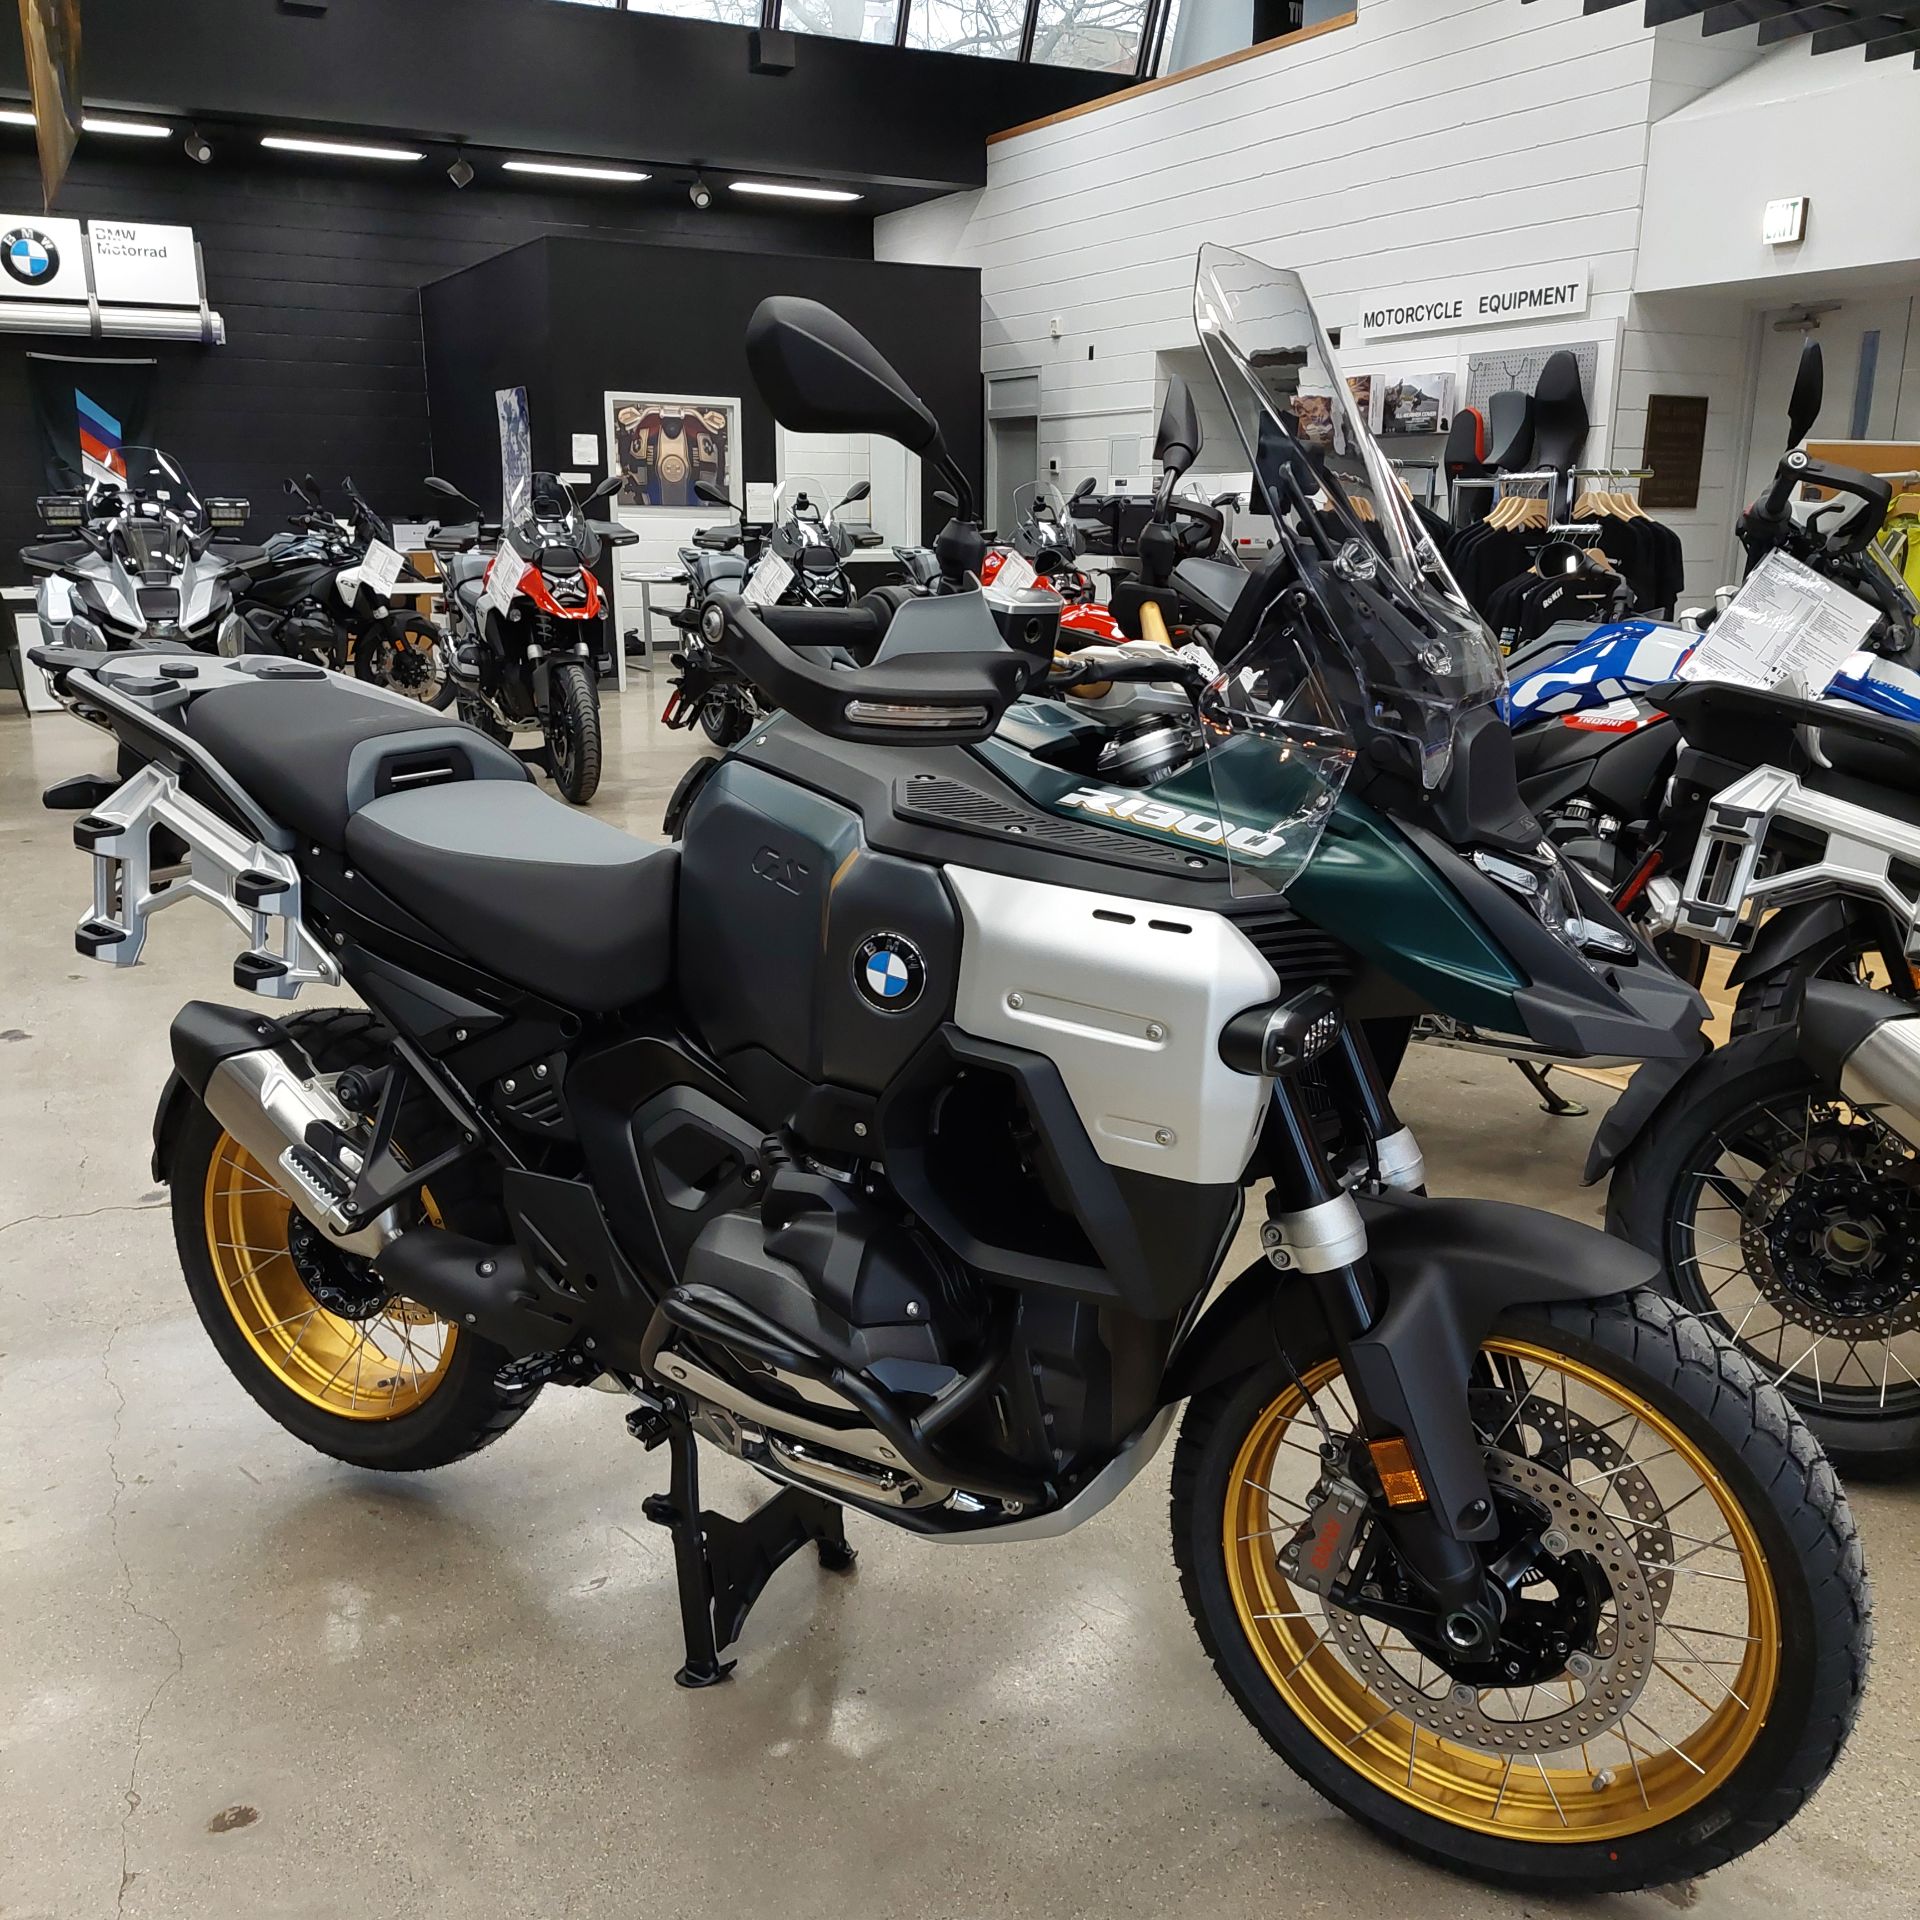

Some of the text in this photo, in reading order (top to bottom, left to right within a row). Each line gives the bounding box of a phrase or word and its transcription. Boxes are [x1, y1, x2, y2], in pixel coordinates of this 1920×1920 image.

[95, 228, 136, 241] BMW
[97, 242, 167, 258] Motorrad
[1363, 284, 1579, 328] MOTORCYCLE EQUIPMENT
[1577, 715, 1626, 728] TROPHY
[1055, 786, 1287, 859] R1300
[751, 844, 809, 896] GS
[863, 938, 919, 970] BMW
[1311, 1515, 1342, 1570] BMW
